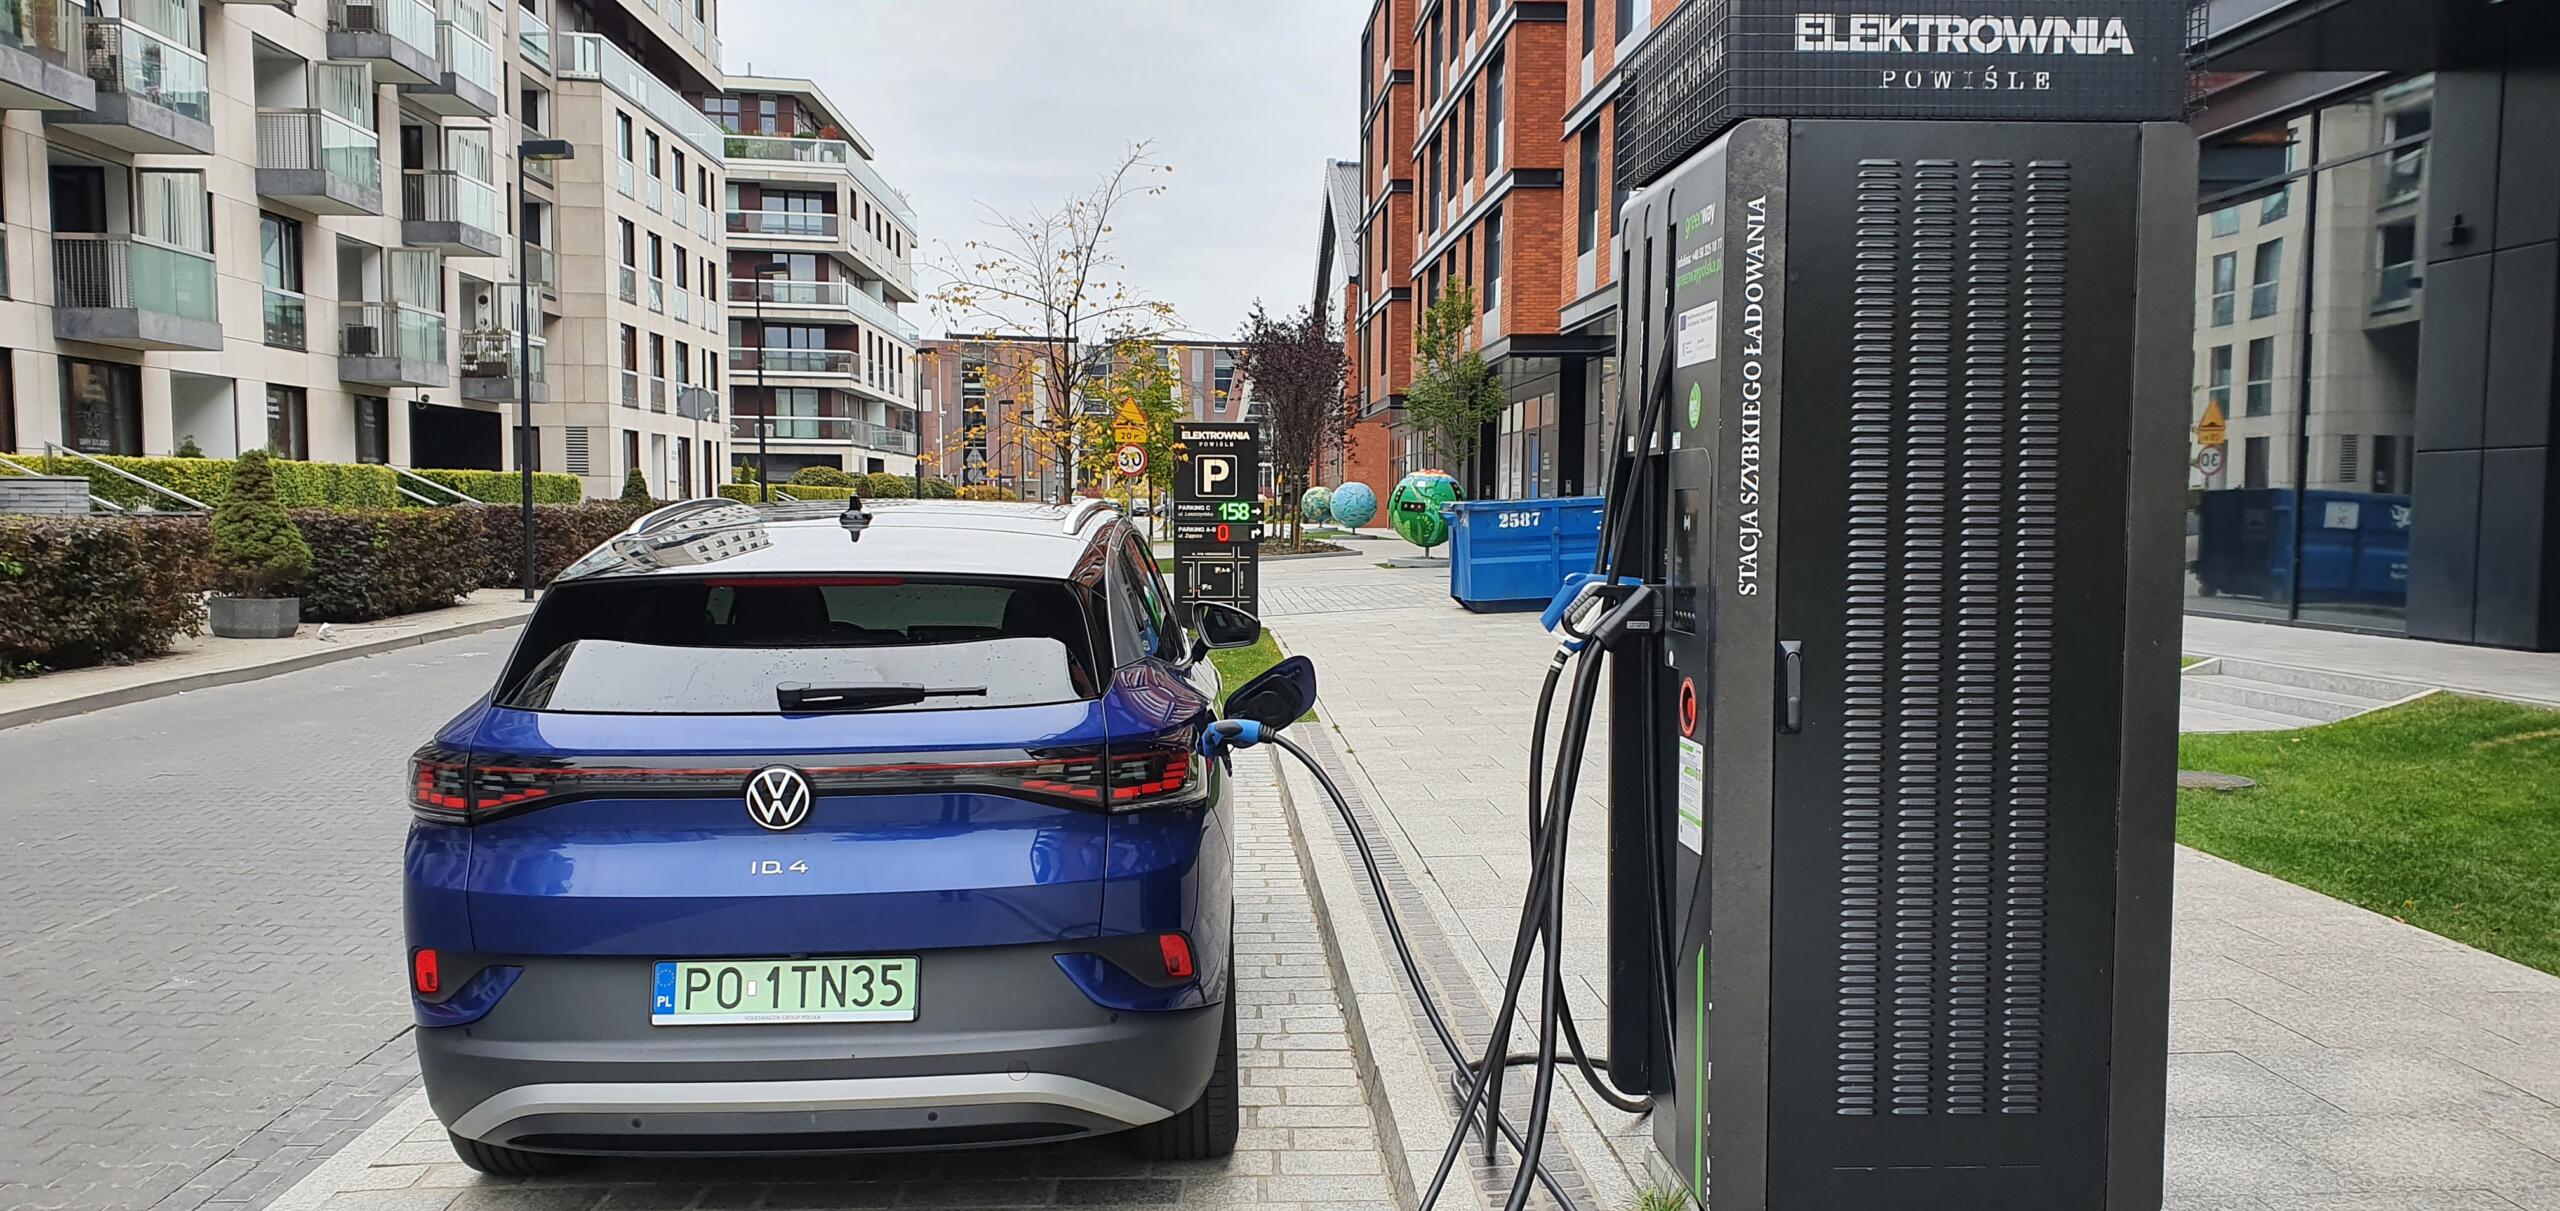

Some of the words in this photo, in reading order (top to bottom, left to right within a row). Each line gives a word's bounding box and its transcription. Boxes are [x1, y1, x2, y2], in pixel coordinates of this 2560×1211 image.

[1795, 13, 2135, 55] ELEKTROWNIA
[1878, 66, 2052, 90] POWIŚLE
[1744, 195, 1767, 356] ŁADOWANIA
[1121, 432, 1132, 440] 20
[1181, 431, 1251, 440] ELEKTROWNIA
[1740, 361, 1761, 505] SZYBKIEGO
[1120, 451, 1142, 467] 30
[1203, 459, 1230, 493] P
[1218, 502, 1250, 520] 158
[1498, 511, 1541, 528] 2587
[1217, 524, 1229, 541] 0
[1738, 508, 1763, 596] STACJA
[685, 967, 742, 1010] PO
[766, 964, 903, 1009] 1TN35
[657, 995, 672, 1008] PL
